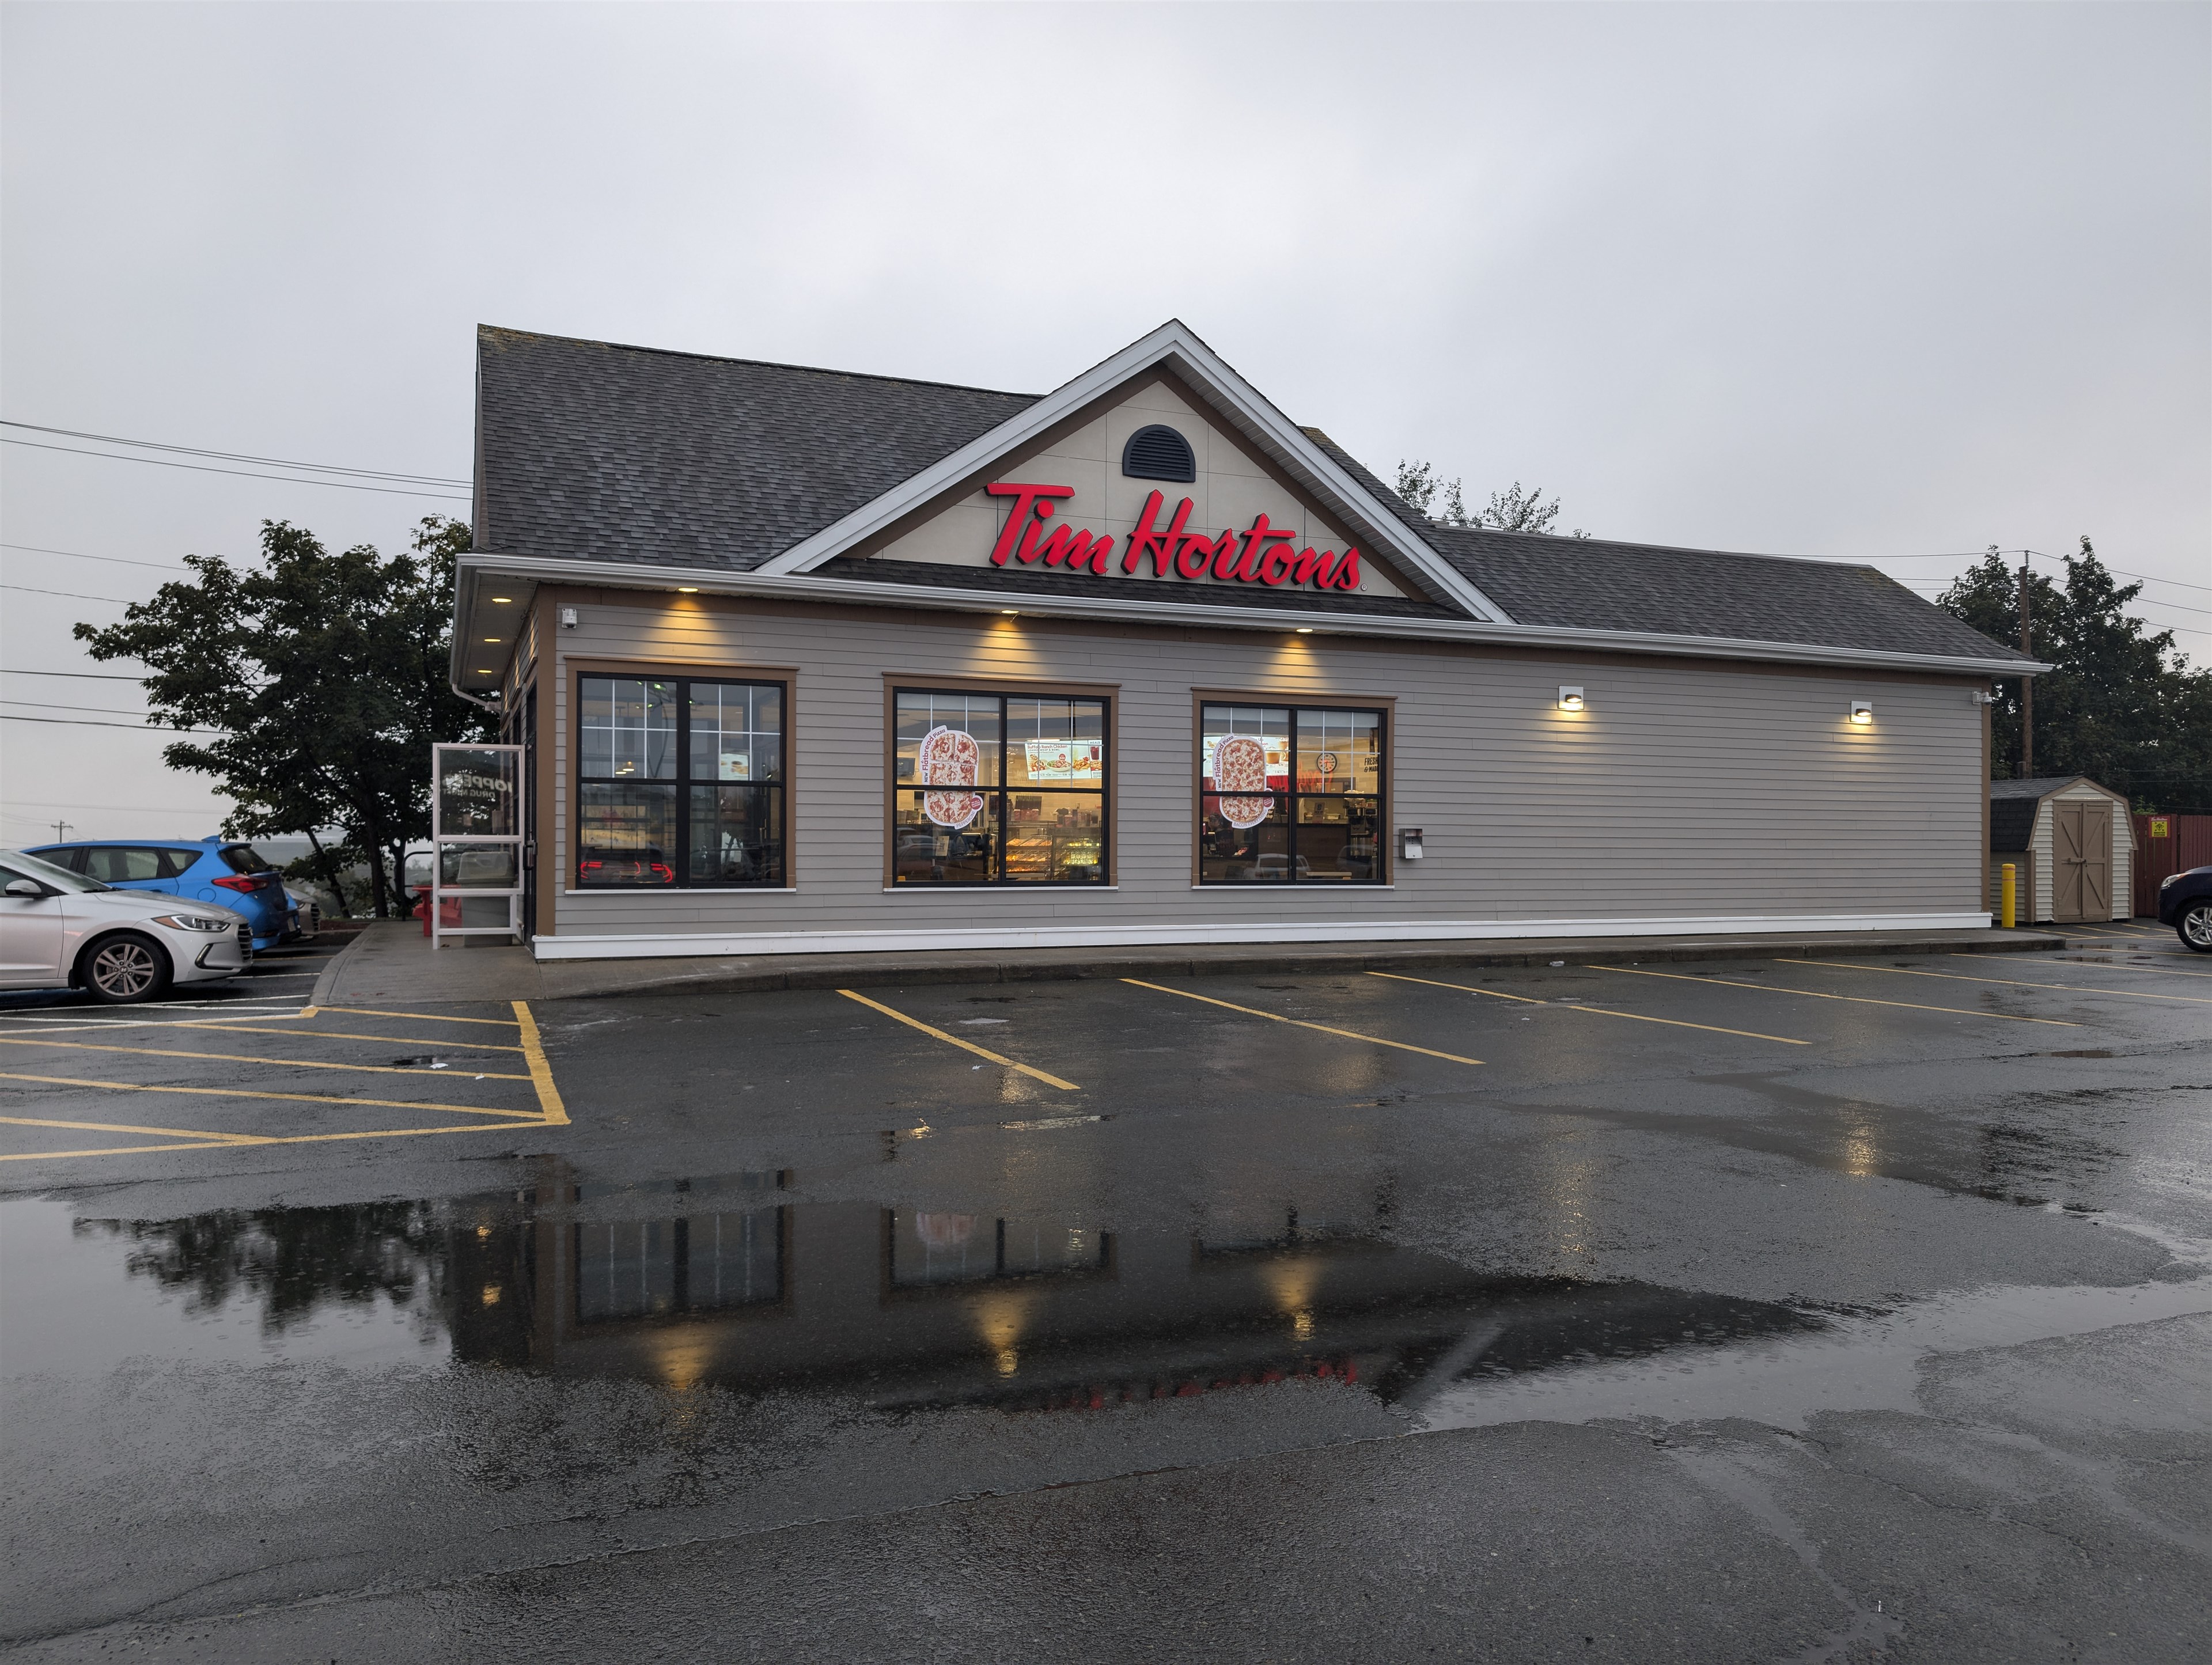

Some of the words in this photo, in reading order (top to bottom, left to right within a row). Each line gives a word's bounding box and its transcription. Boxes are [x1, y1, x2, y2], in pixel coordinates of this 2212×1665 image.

[984, 483, 1115, 575] Tim
[1120, 489, 1361, 591] Hortons
[922, 735, 934, 771] Flatbread
[933, 729, 945, 738] Pizza
[1215, 743, 1224, 777] Flatbread
[1223, 735, 1234, 745] Pizza
[1364, 757, 1378, 766] FRESH
[956, 811, 975, 828] PEPPERONI
[1248, 809, 1267, 826] EVERYTHING
